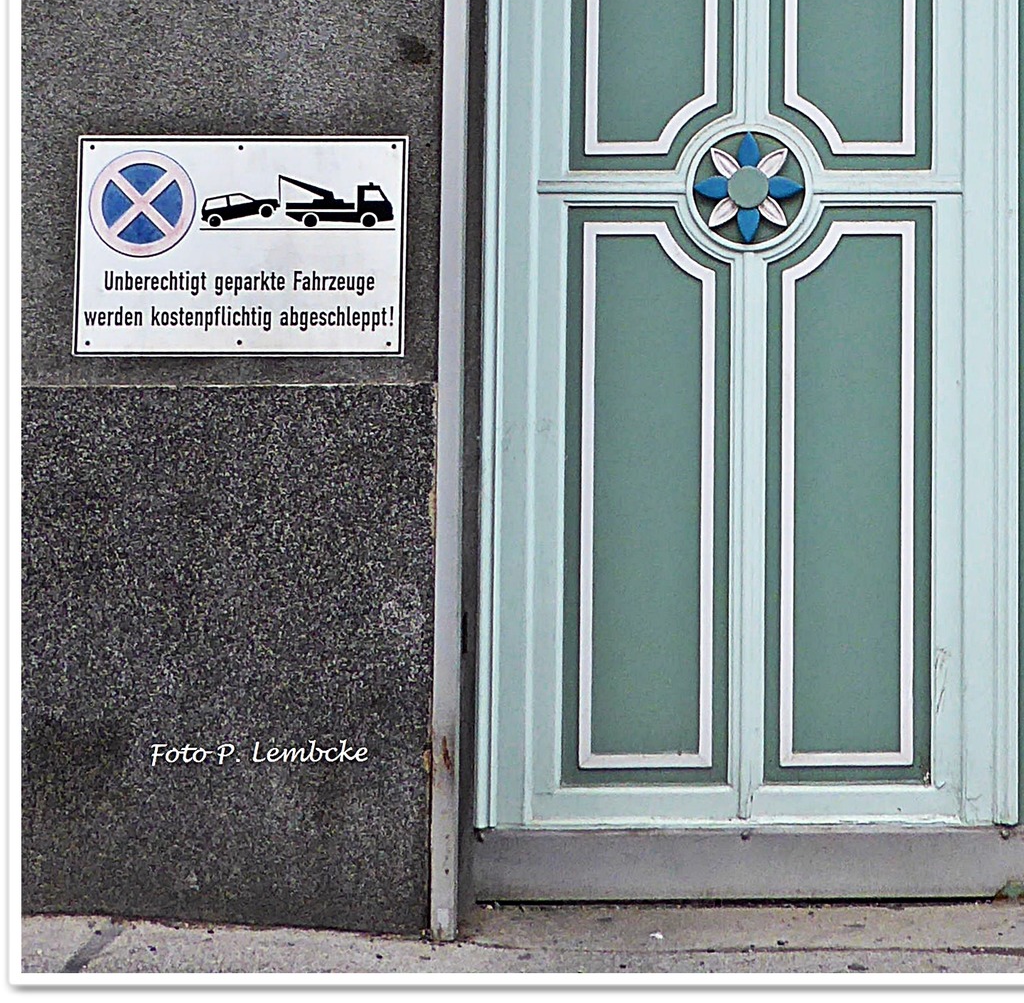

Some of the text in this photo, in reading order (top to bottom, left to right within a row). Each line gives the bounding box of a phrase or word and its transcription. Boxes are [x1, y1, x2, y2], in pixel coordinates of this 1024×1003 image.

[103, 270, 375, 296] Unberechtigt geparkte Fahrzeuge
[83, 306, 395, 332] werden kostenpflichtig abgeschleppt!
